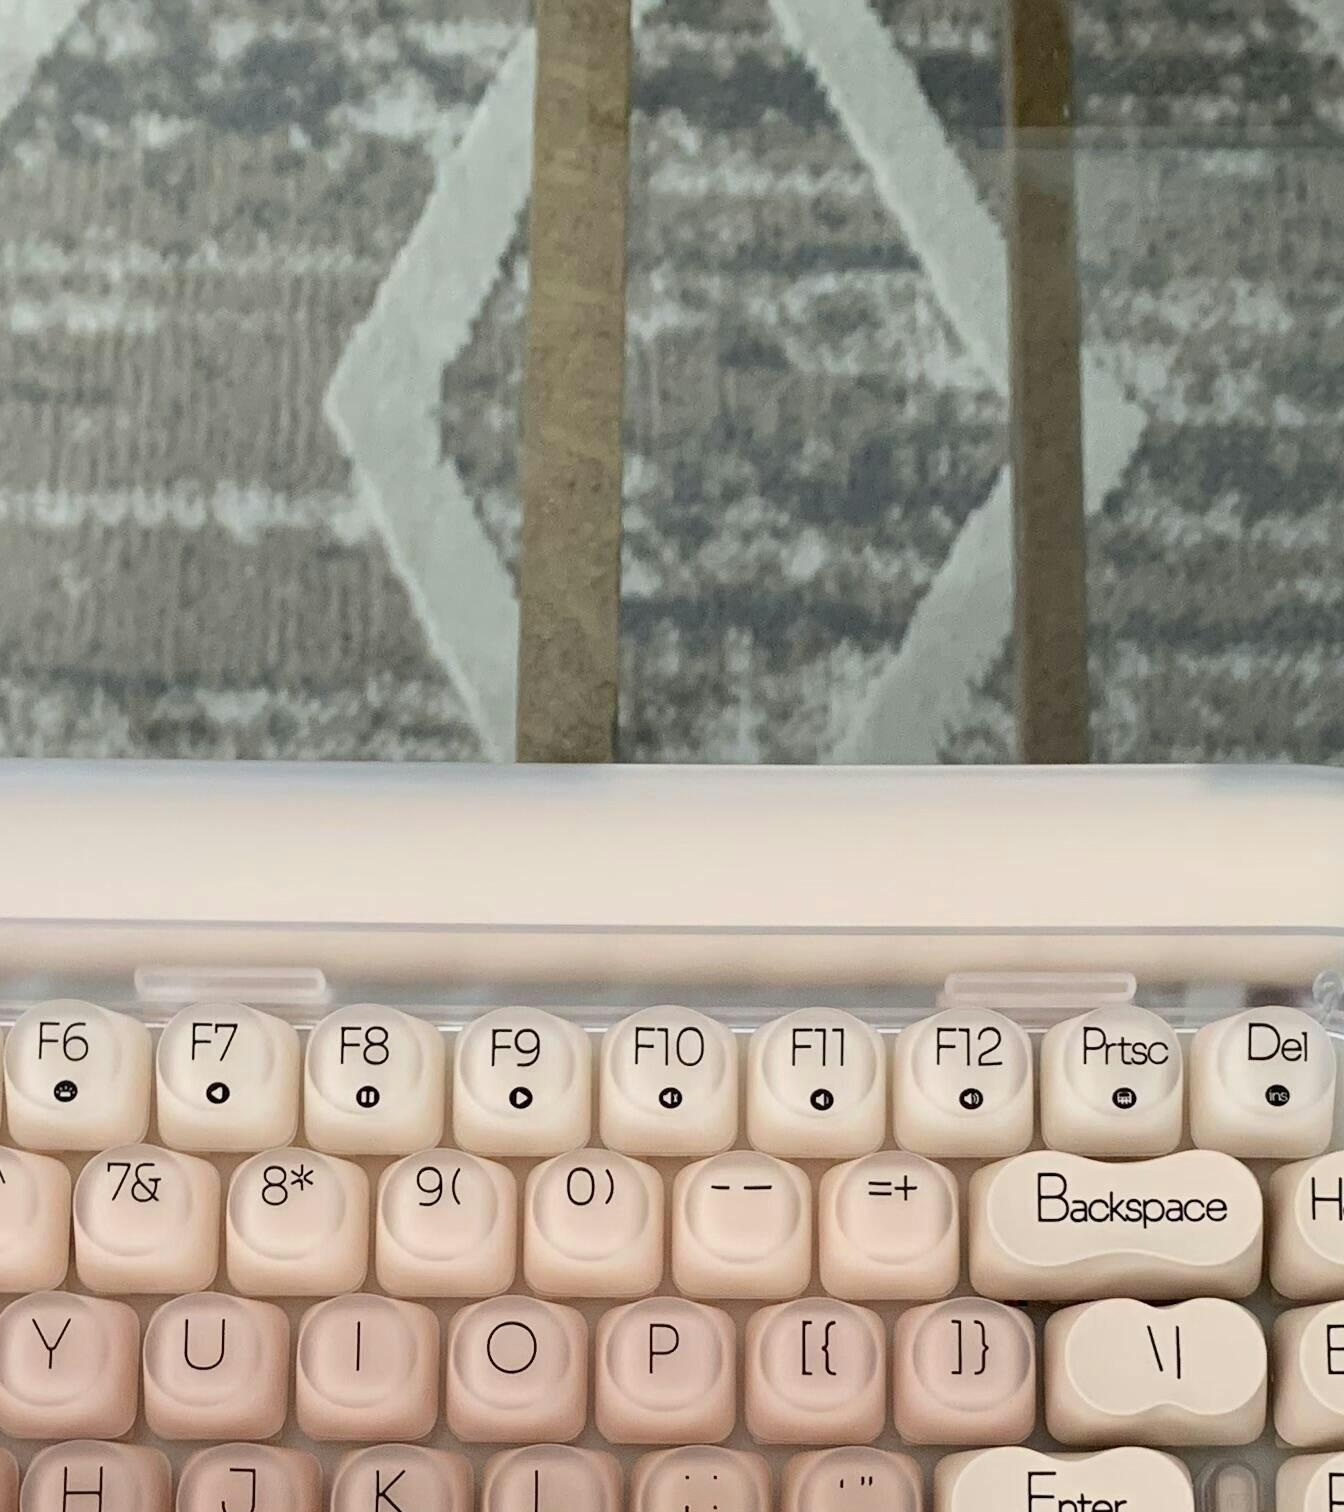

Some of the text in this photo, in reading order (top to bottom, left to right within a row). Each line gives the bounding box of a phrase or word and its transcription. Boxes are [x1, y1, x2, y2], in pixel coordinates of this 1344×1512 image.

[38, 1021, 89, 1062] F6
[191, 1022, 239, 1062] F7
[340, 1025, 390, 1066] F8
[491, 1028, 541, 1068] F9
[634, 1026, 705, 1067] F10
[791, 1027, 845, 1067] F11
[936, 1026, 1003, 1067] F12
[1082, 1026, 1169, 1066] Prtsc
[1247, 1022, 1308, 1063] Del
[1268, 1090, 1289, 1103] ins
[106, 1161, 162, 1203] 7&
[867, 1174, 918, 1201] =+
[1037, 1172, 1228, 1230] Backspace
[31, 1318, 72, 1370] Y
[183, 1318, 226, 1371] U
[486, 1320, 538, 1375] O
[649, 1323, 680, 1375] P
